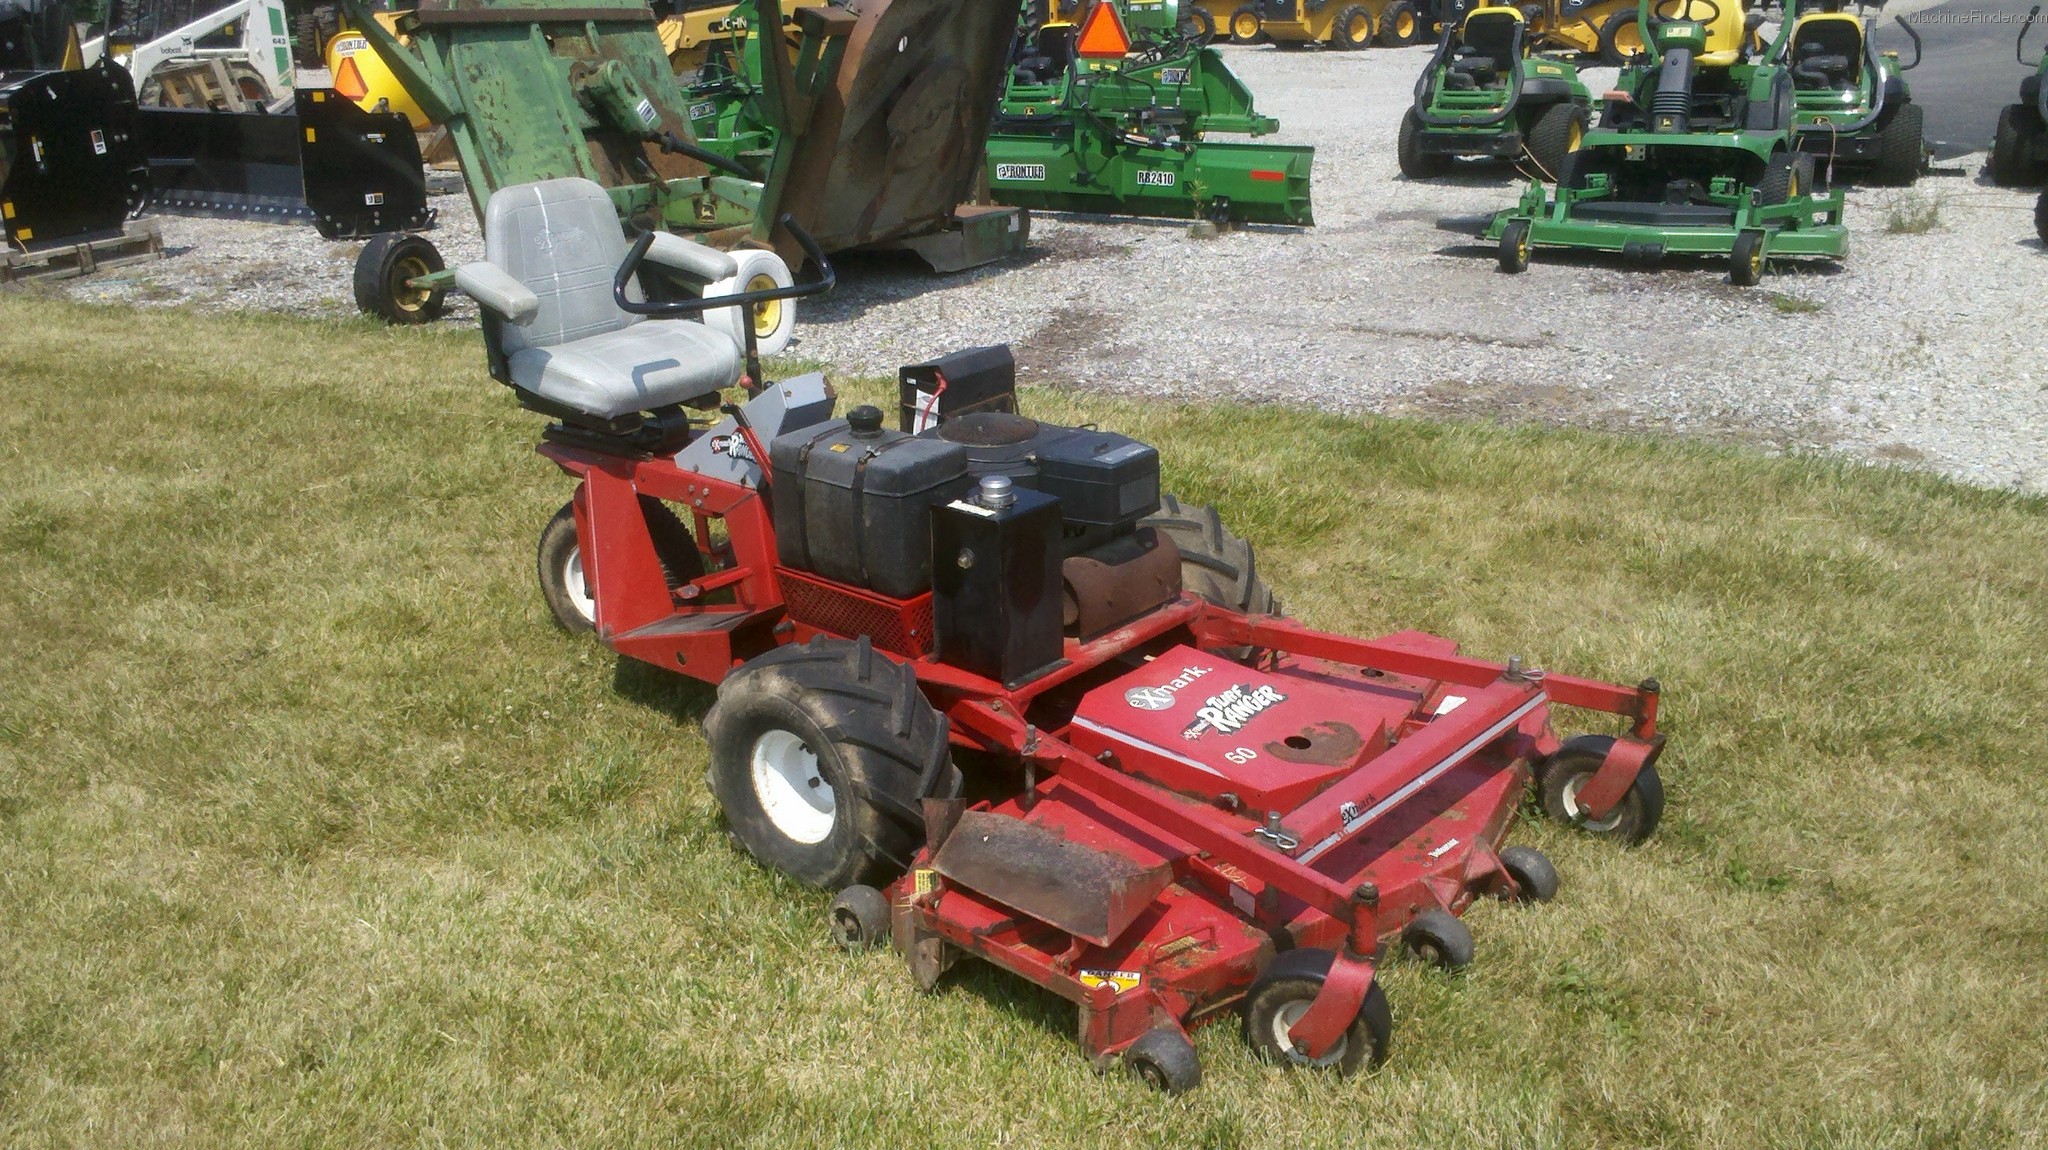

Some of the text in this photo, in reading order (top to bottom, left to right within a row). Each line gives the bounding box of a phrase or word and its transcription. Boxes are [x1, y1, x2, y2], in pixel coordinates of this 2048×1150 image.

[160, 46, 182, 54] bobcat
[1006, 165, 1044, 179] FRONTIER
[1138, 172, 1173, 185] RB2410
[1205, 684, 1243, 710] TURF
[1196, 685, 1284, 733] RANGER
[1225, 747, 1257, 764] 60
